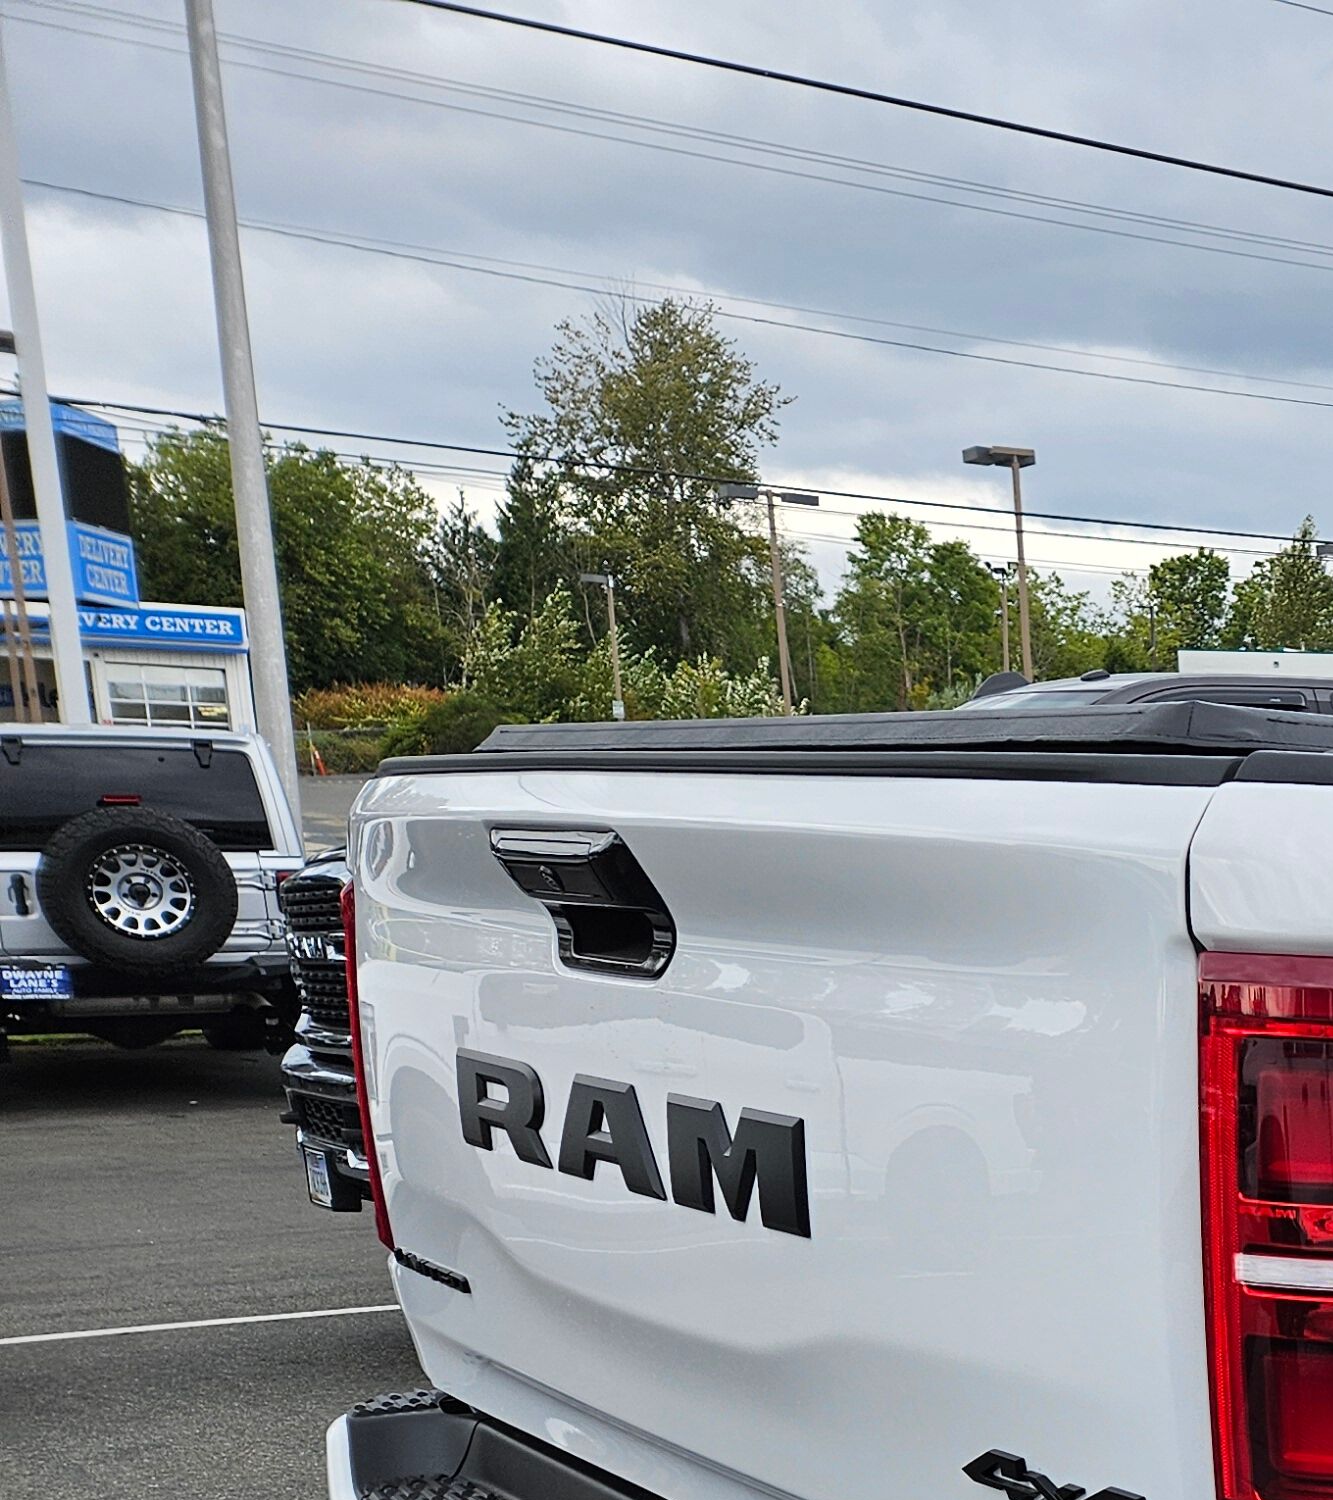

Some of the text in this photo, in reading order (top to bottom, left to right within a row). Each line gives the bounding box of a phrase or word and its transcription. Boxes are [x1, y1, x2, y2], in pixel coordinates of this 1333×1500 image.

[78, 533, 129, 569] DELIVERY
[86, 563, 130, 595] CENTER
[144, 615, 234, 636] CENTER
[1, 970, 63, 979] DWAYNE
[10, 979, 59, 988] LANE'S
[457, 1047, 812, 1239] RAM
